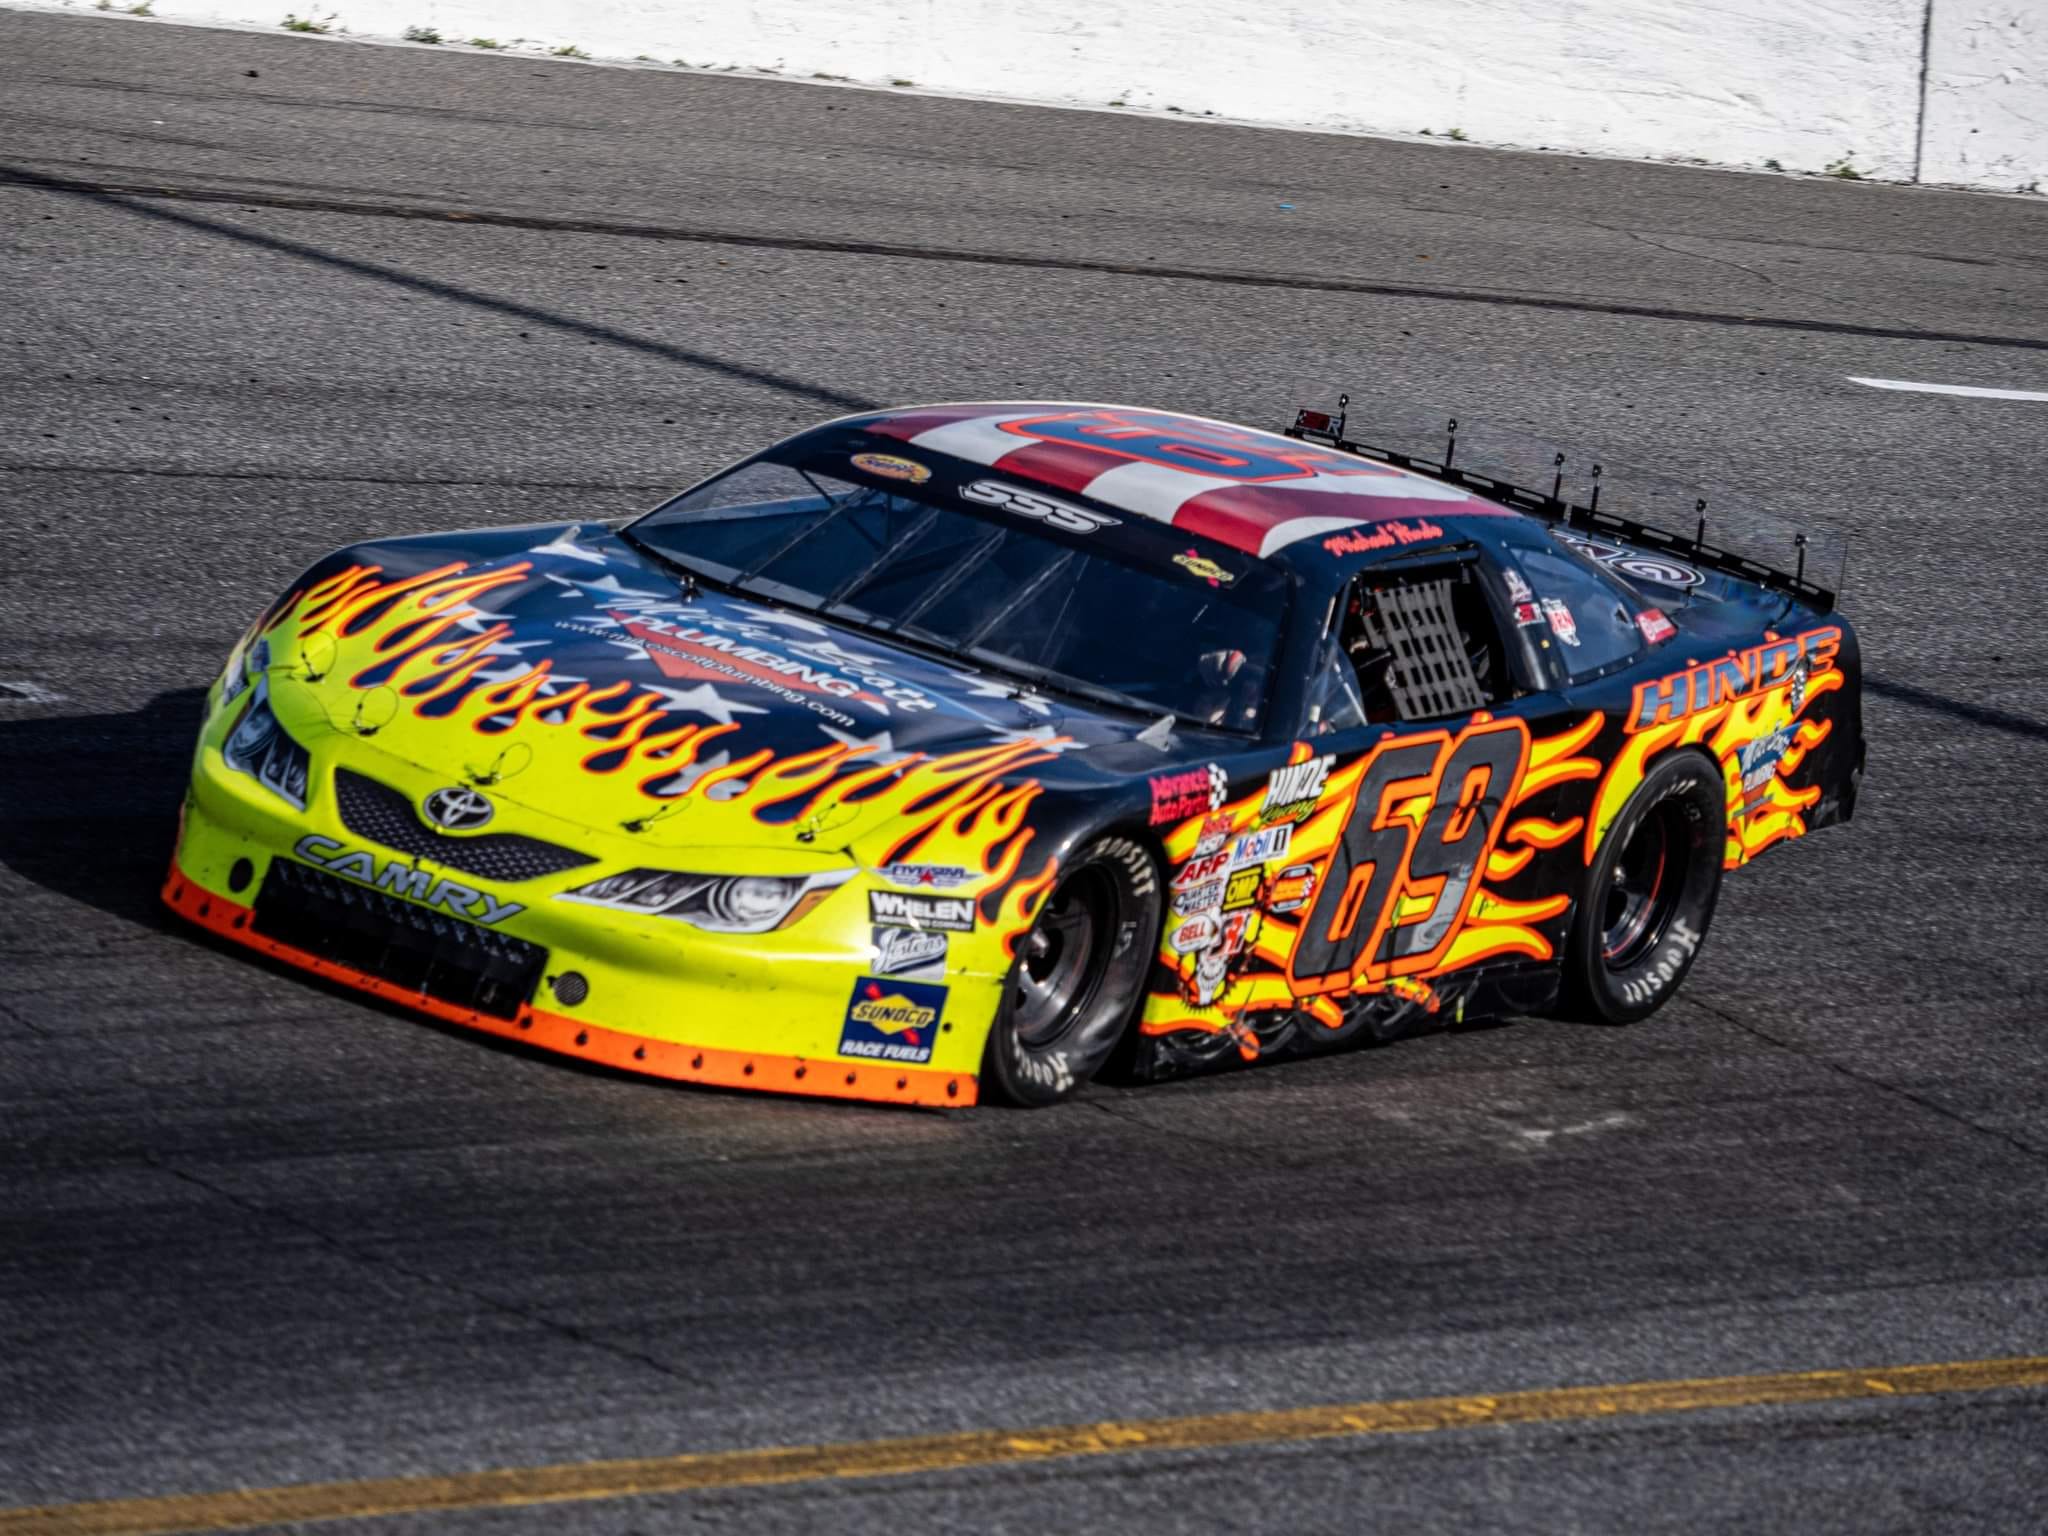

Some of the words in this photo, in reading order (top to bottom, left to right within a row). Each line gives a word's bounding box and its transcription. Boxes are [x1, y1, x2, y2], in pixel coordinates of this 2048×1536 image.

[622, 615, 862, 698] PLUMBING
[1623, 625, 1843, 735] HINDE
[1261, 753, 1337, 813] HINDE
[295, 834, 528, 924] CAMRY
[1176, 851, 1230, 885] ARP
[1287, 717, 1532, 997] 69
[870, 891, 975, 922] WHELEN
[1178, 921, 1206, 944] BELL
[855, 1003, 931, 1027] SUNOCO
[840, 1039, 882, 1056] RACE
[883, 1043, 931, 1062] FUELS
